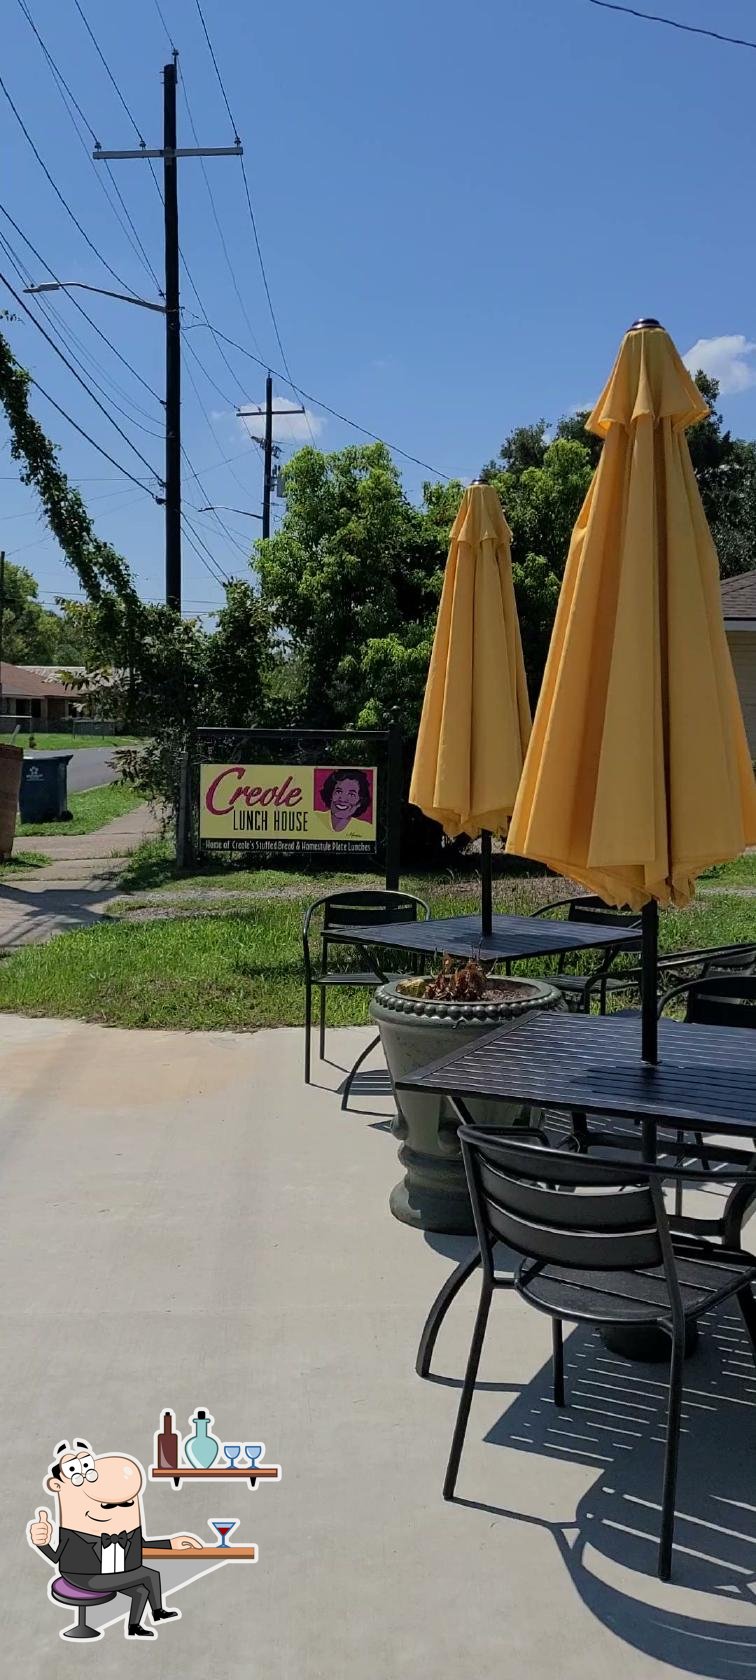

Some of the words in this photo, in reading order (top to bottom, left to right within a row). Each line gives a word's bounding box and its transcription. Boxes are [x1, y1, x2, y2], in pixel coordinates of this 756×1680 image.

[206, 767, 303, 815] Creole
[233, 810, 268, 831] LUNCH
[273, 811, 308, 832] HOUSE
[205, 840, 222, 849] Home
[223, 840, 230, 849] of
[232, 840, 255, 850] Creole's
[295, 841, 300, 850] &
[301, 841, 332, 852] Homestyle
[347, 842, 371, 852] Lunches
